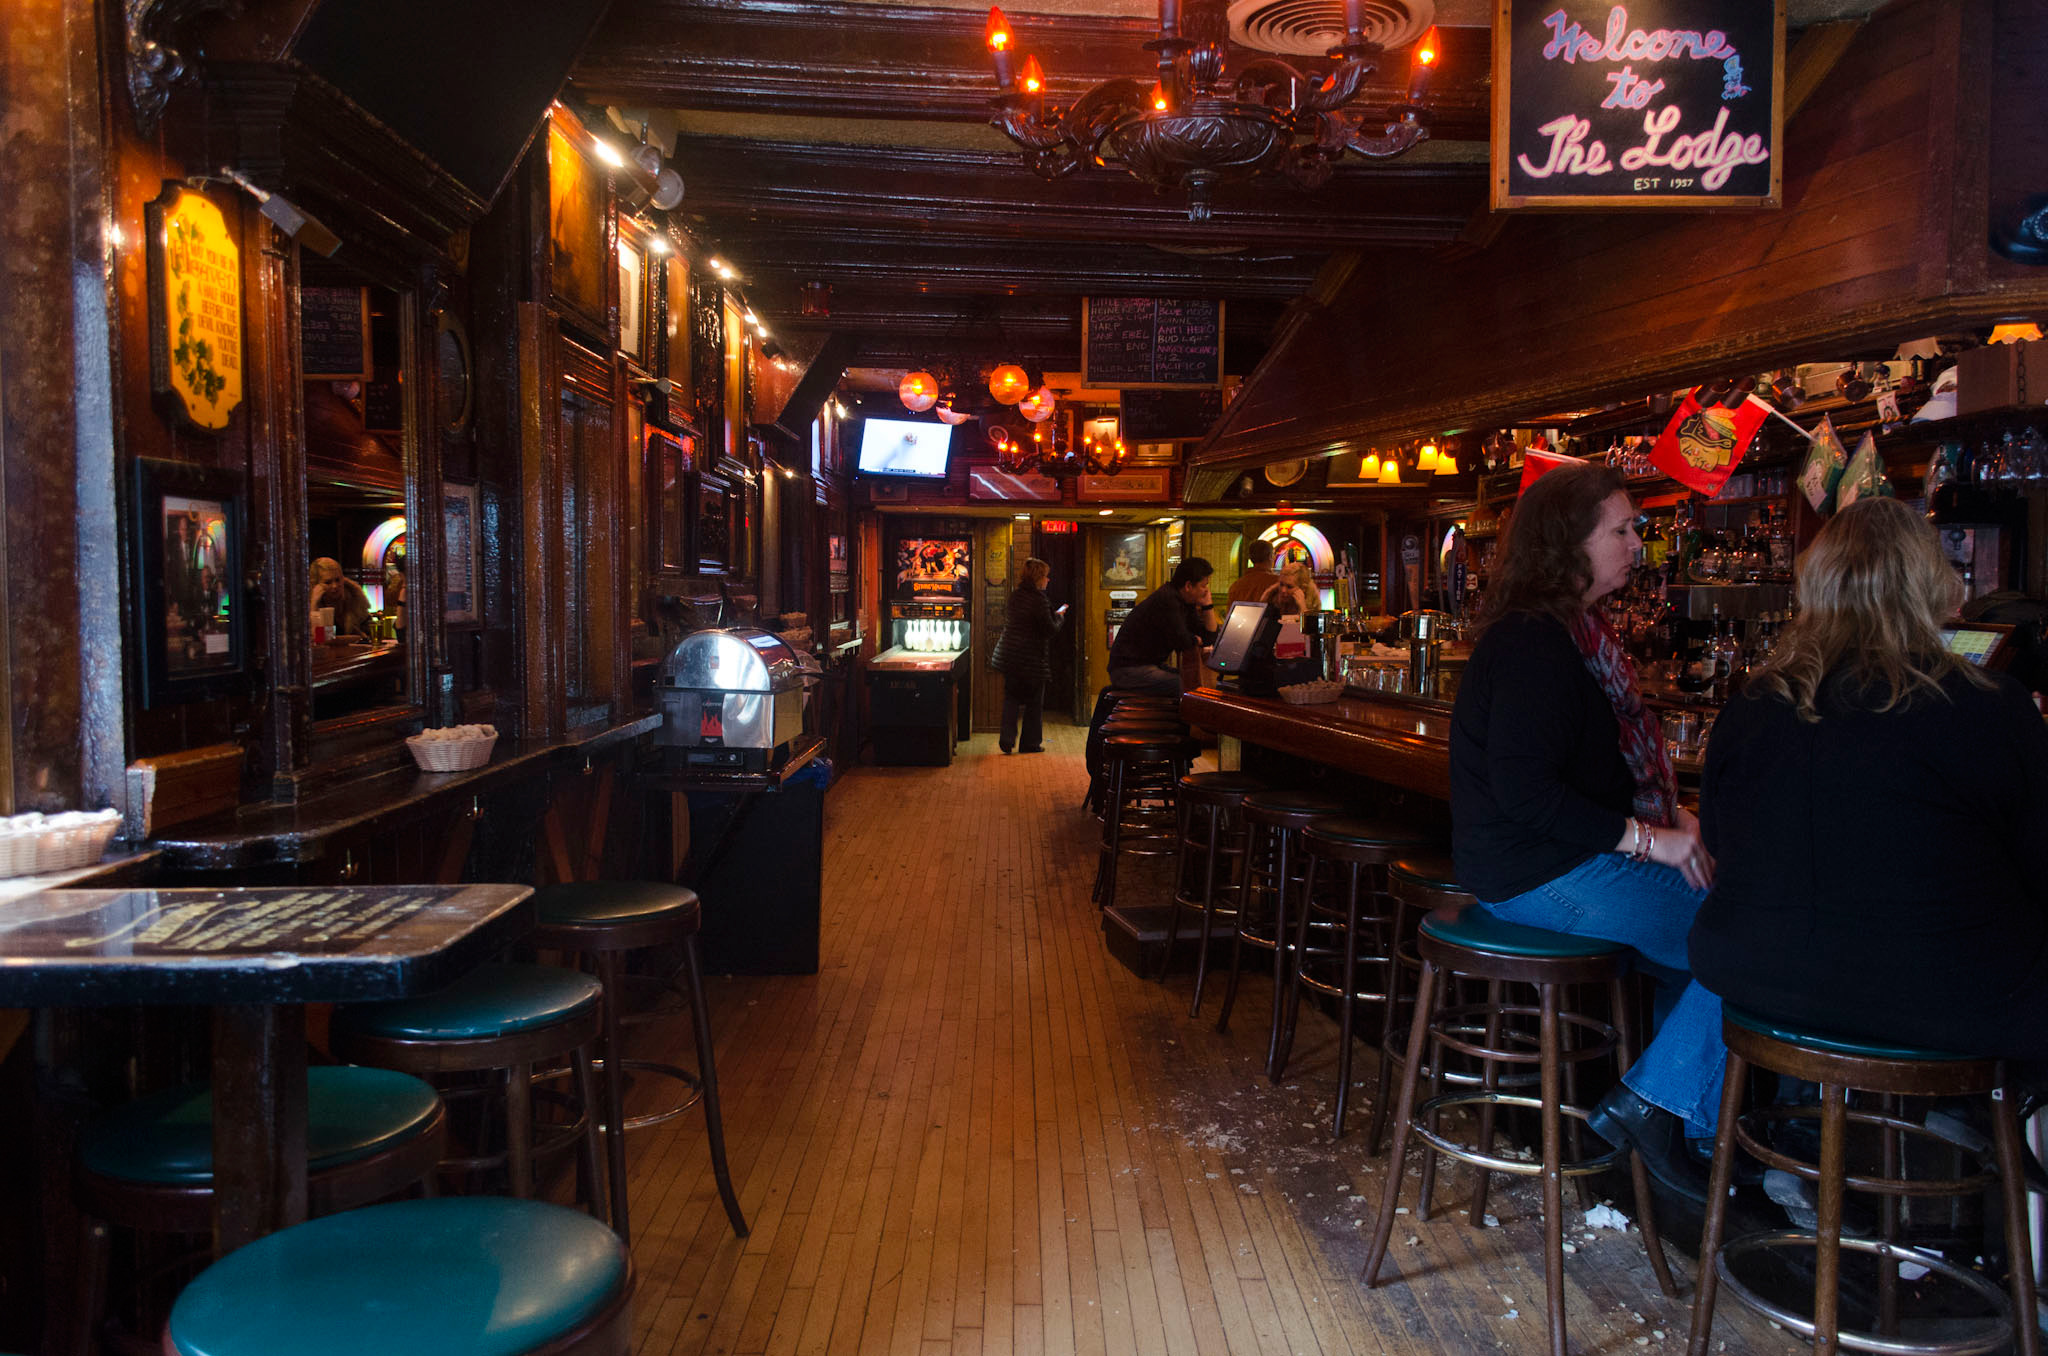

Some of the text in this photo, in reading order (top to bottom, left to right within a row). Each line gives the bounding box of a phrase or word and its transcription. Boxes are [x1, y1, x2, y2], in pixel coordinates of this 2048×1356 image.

[1542, 5, 1736, 63] Welcome
[1600, 65, 1665, 109] to
[1517, 105, 1769, 191] The Lodge
[1633, 177, 1694, 191] EST 1957
[206, 249, 218, 265] YOU
[202, 299, 237, 324] BEFORE THE
[220, 290, 237, 308] HOUR
[198, 314, 238, 339] DEVIL KNOWS
[1158, 335, 1178, 344] BUD
